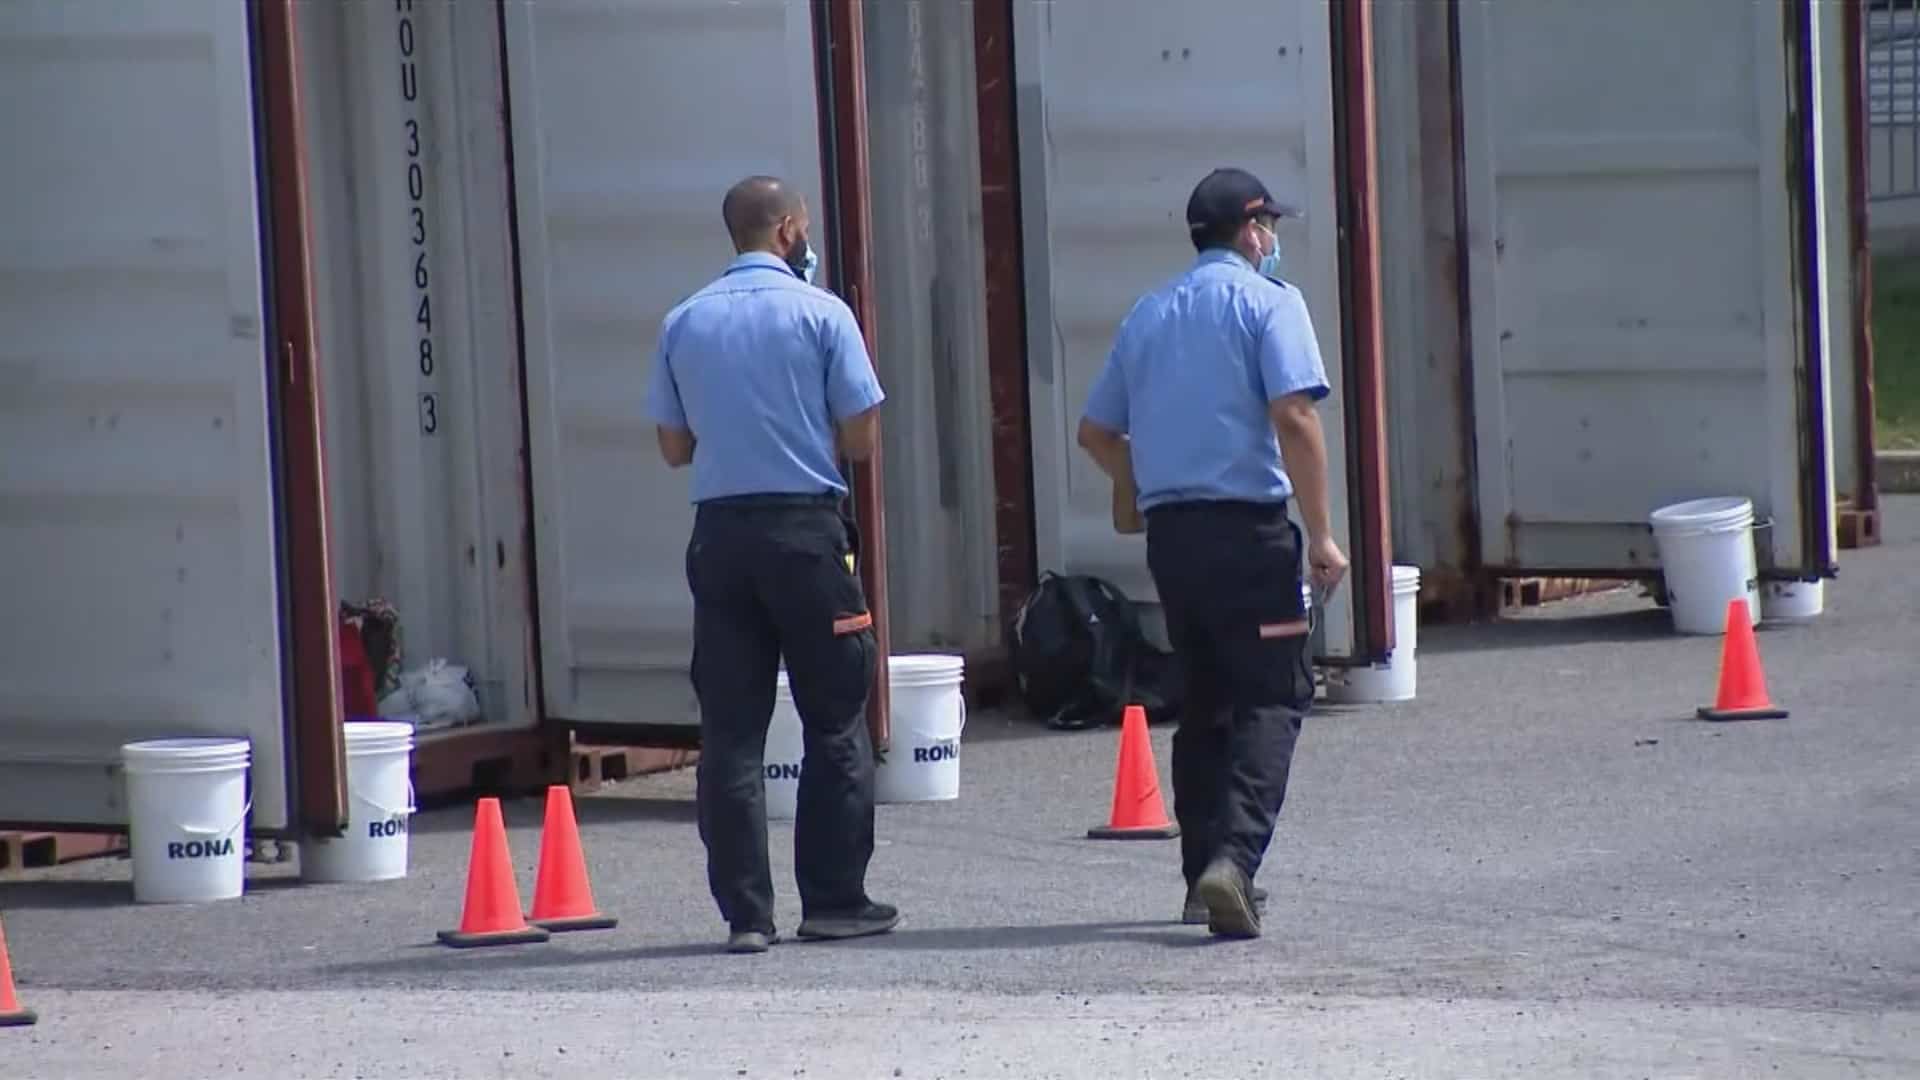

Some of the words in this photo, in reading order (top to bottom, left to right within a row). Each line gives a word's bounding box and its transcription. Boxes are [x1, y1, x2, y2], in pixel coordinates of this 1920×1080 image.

[763, 763, 800, 780] ON
[369, 819, 407, 838] RON
[168, 838, 235, 860] RONA
